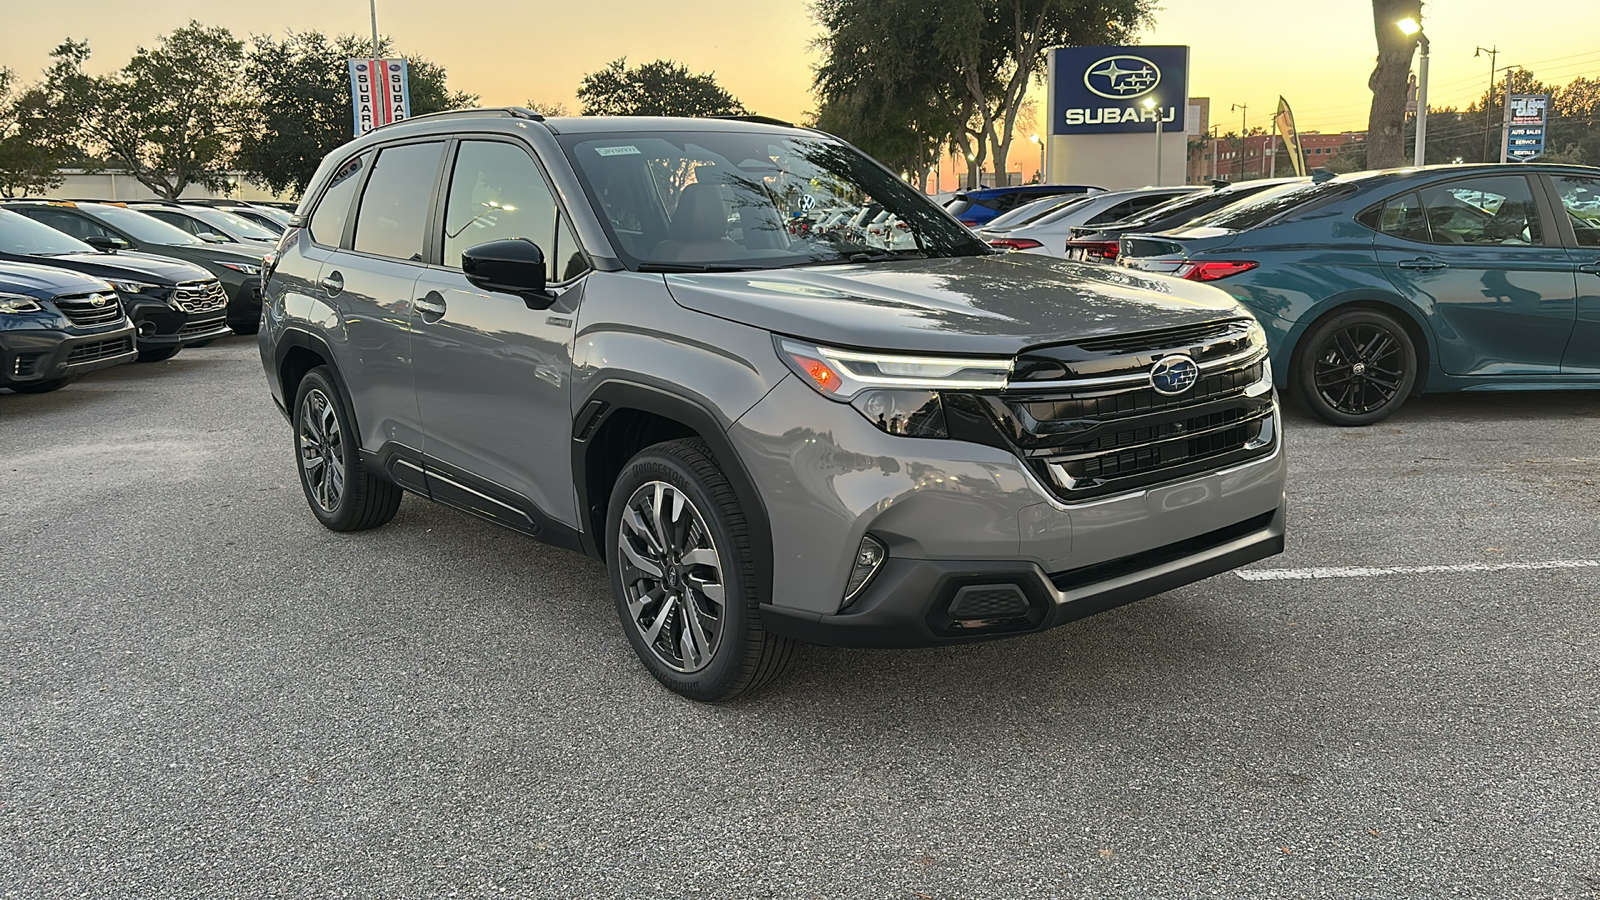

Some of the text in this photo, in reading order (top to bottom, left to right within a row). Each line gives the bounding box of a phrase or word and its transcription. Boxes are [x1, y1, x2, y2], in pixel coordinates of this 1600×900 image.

[358, 74, 371, 132] SUBARU
[391, 74, 404, 122] SUBAR
[1066, 107, 1175, 125] SUBARU
[632, 462, 691, 489] BRIDGESTONE
